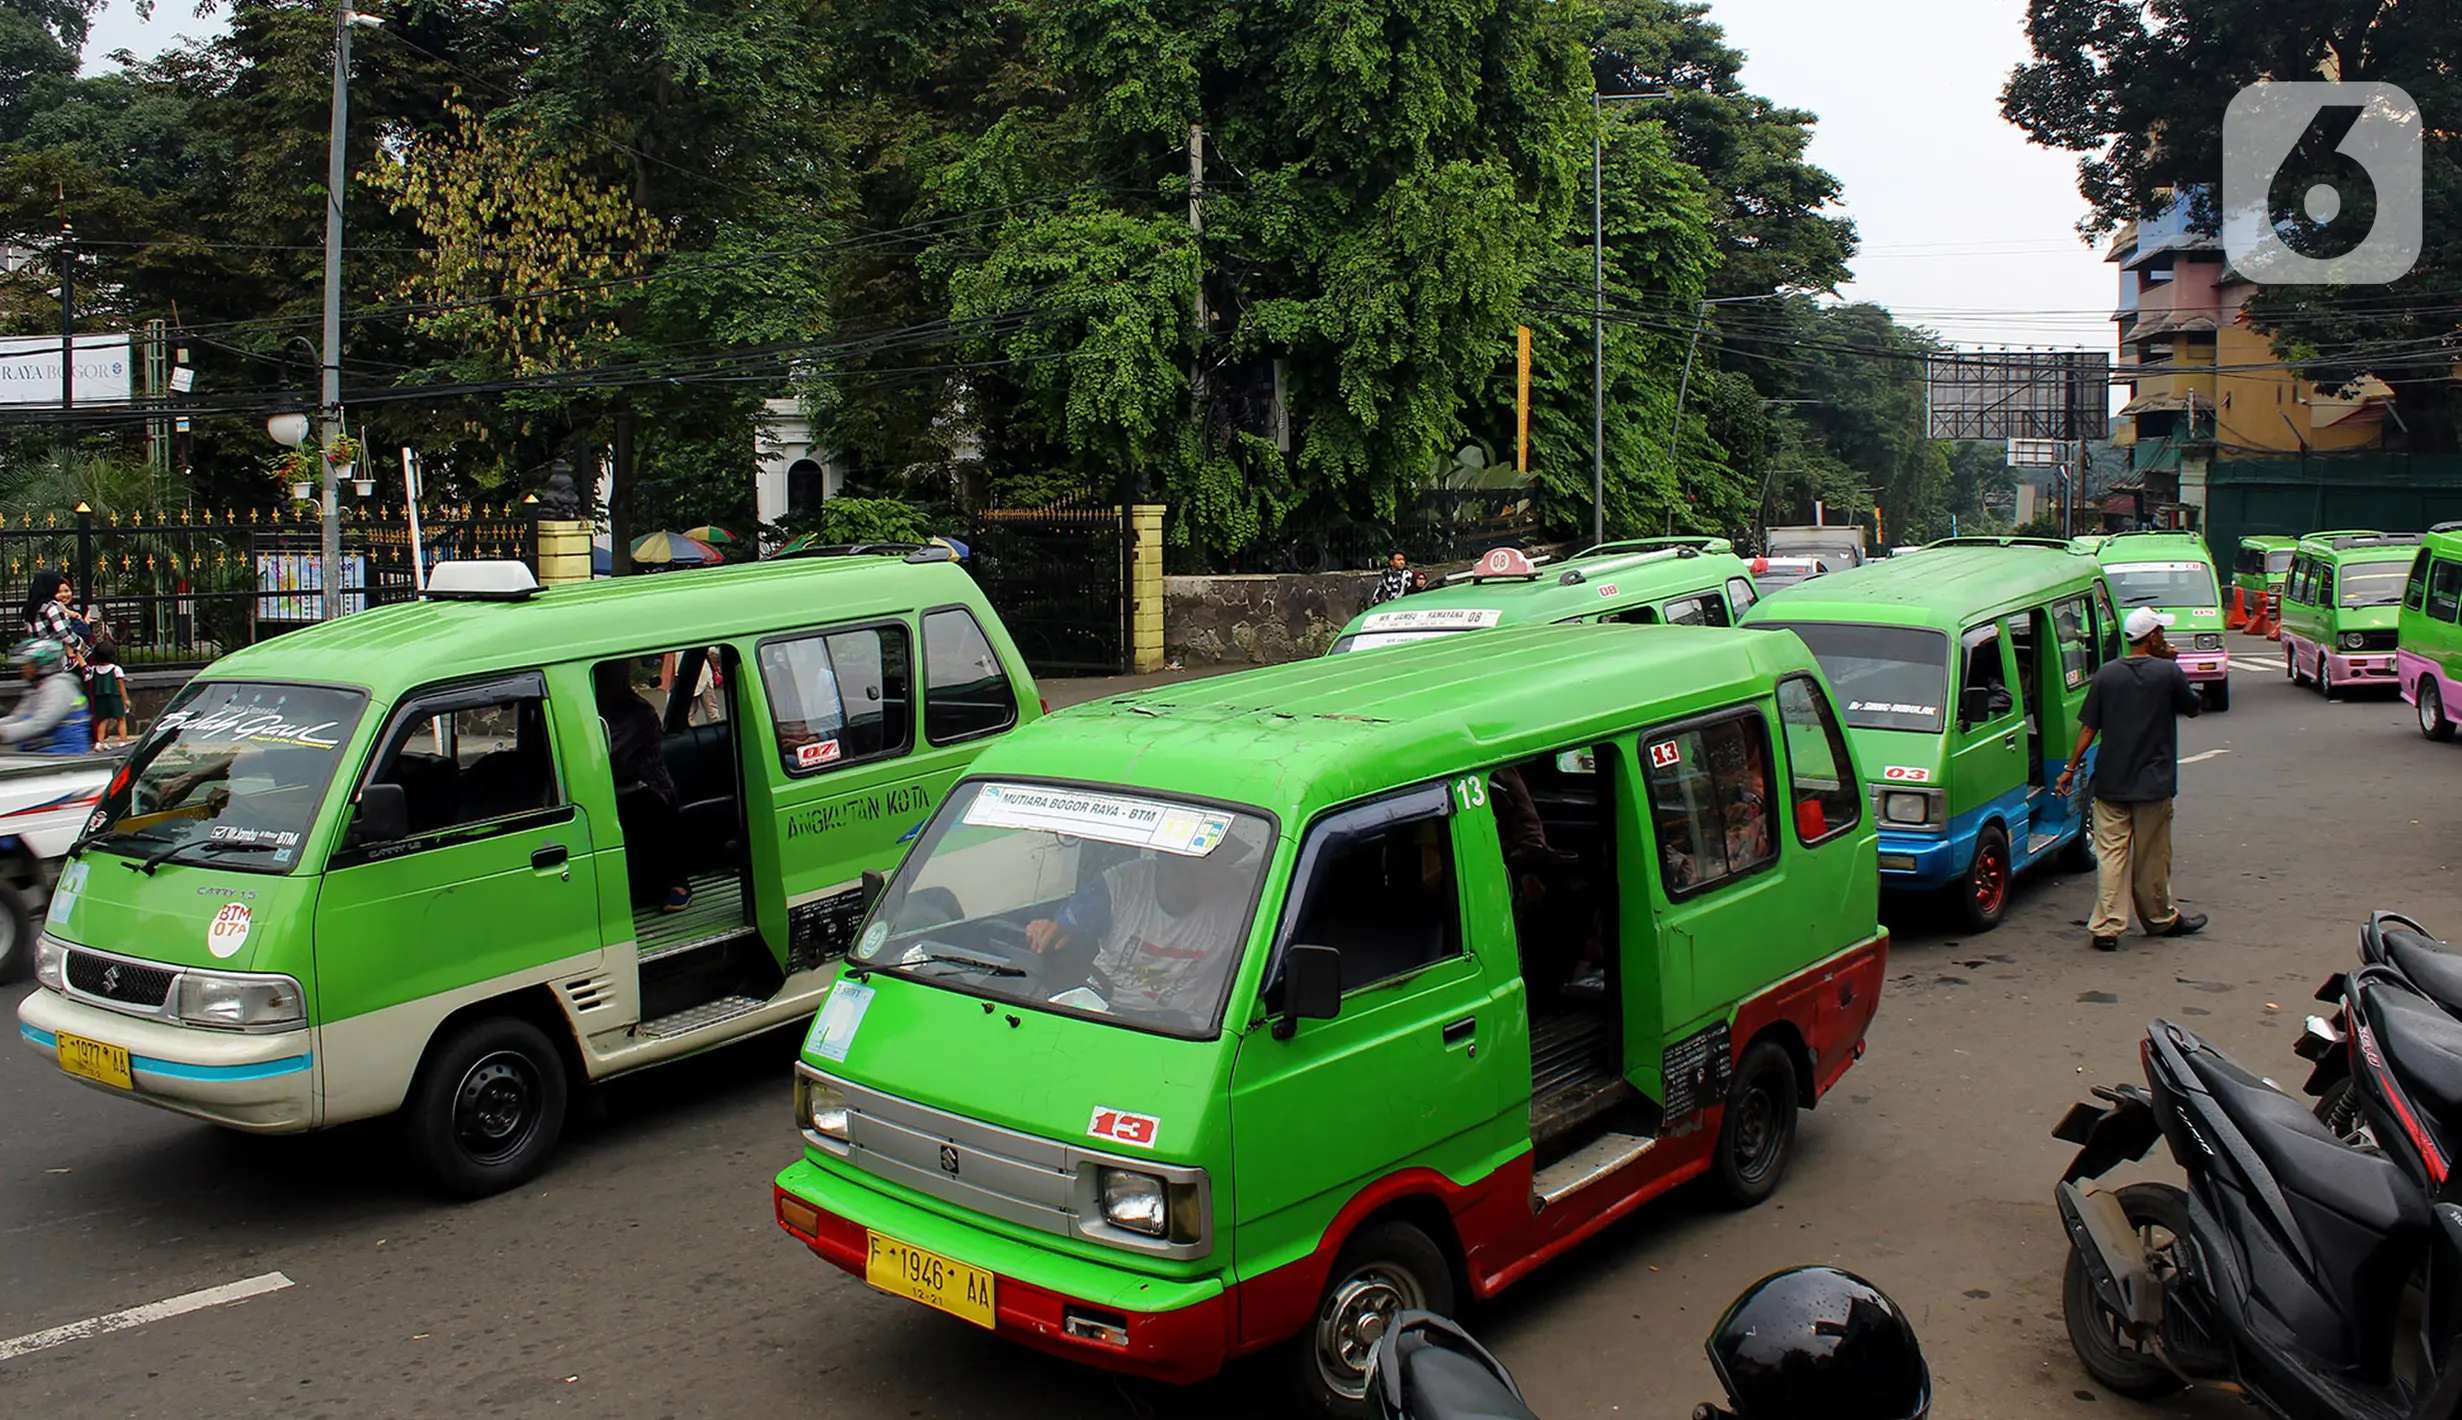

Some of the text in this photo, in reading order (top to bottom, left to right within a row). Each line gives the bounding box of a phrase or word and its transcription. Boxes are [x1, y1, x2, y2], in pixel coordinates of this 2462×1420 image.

[2, 363, 43, 380] RAYA
[1493, 554, 1506, 568] 08
[1653, 742, 1679, 765] 13
[1886, 767, 1927, 780] 03
[1456, 774, 1486, 810] 13
[787, 785, 931, 840] ANGKUTAN KOTA
[1001, 793, 1048, 809] MUTIARA
[1050, 797, 1090, 814] BOGOR
[1091, 803, 1119, 817] RAYA
[1128, 808, 1157, 822] BTM
[276, 831, 301, 846] BTM
[196, 887, 237, 898] CARRY
[219, 904, 253, 922] BTM
[214, 922, 247, 937] 07A
[59, 1034, 66, 1058] F
[76, 1040, 101, 1069] 1977
[112, 1049, 129, 1077] AA
[1092, 1111, 1155, 1144] 13
[871, 1236, 990, 1309] F 1946 AA
